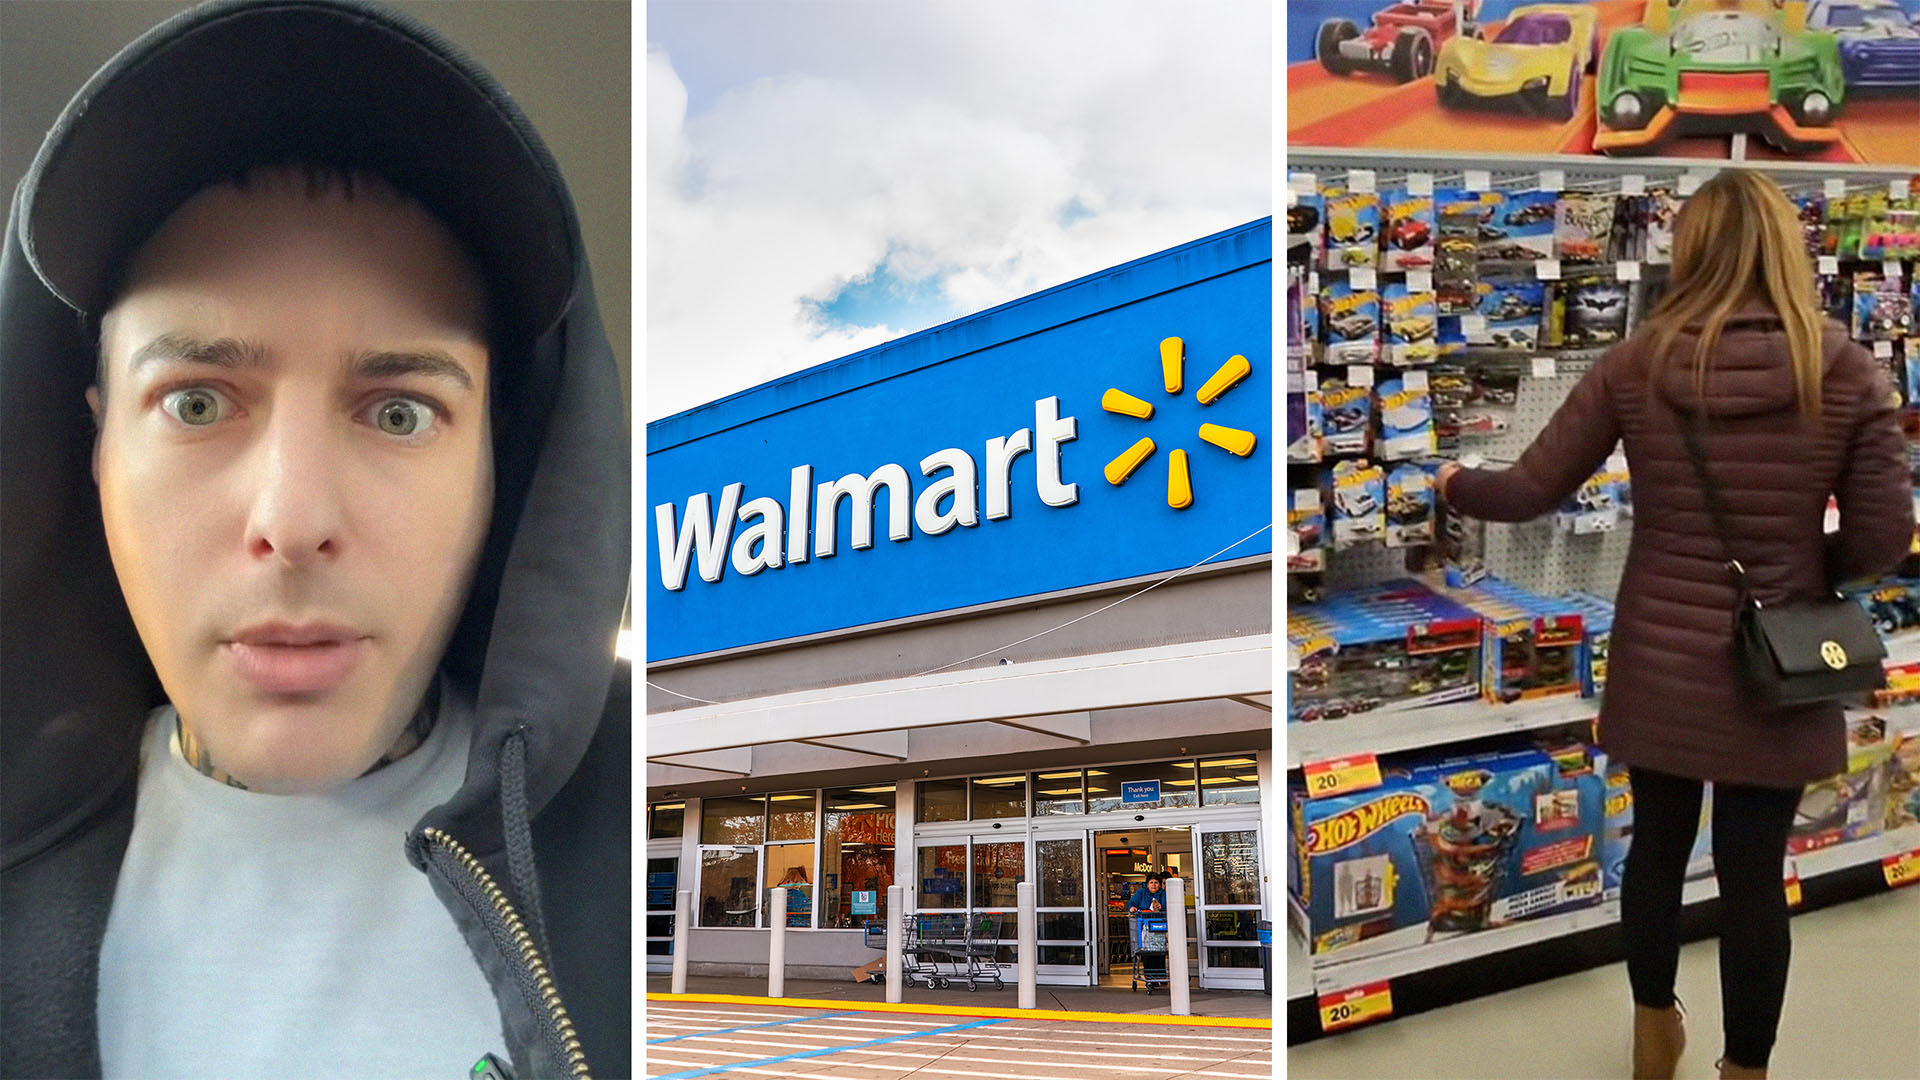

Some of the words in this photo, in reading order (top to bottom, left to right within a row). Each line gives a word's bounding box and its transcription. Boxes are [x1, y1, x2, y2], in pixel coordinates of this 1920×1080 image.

[655, 396, 1079, 591] Walmart
[1316, 774, 1338, 790] 20
[875, 828, 896, 843] Here
[1313, 815, 1358, 851] HOT
[1330, 1005, 1350, 1021] 20
